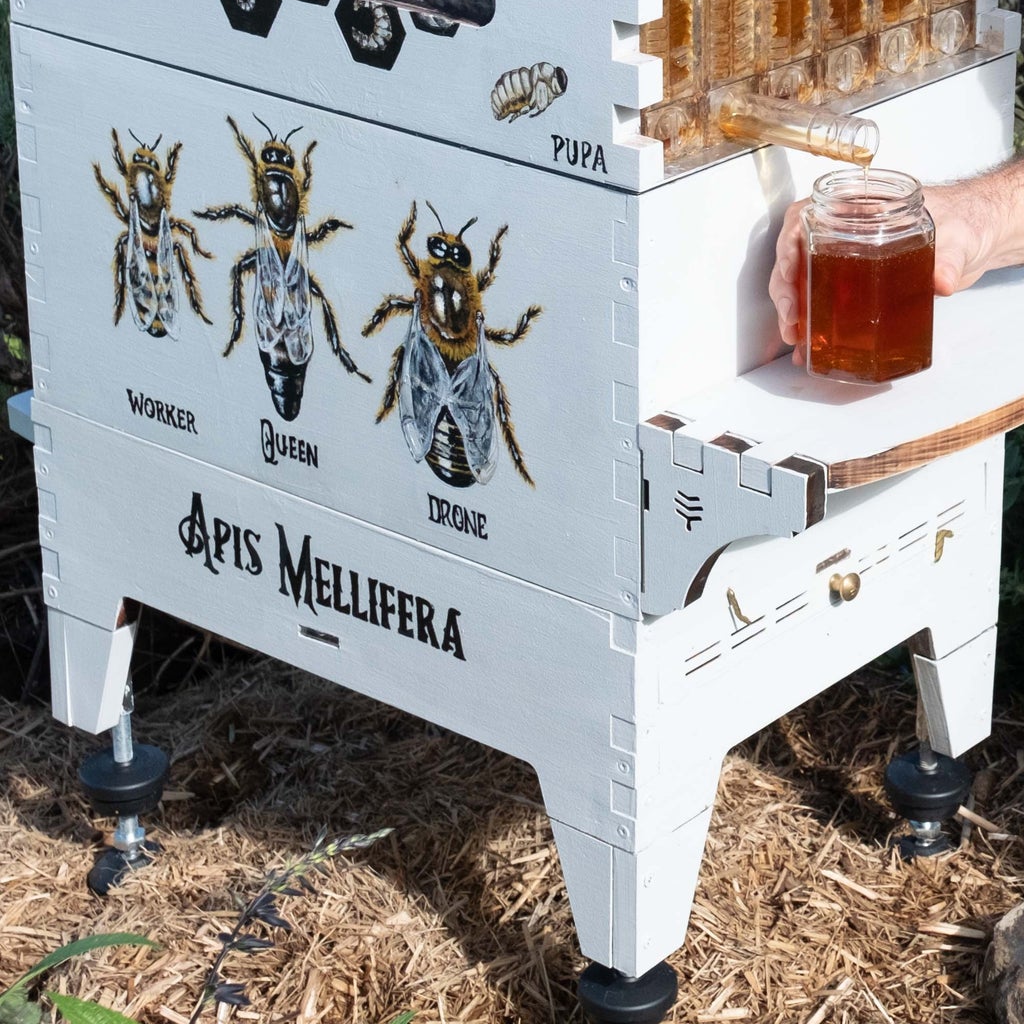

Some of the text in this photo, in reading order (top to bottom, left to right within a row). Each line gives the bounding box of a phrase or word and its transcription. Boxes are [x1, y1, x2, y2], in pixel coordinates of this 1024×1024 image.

[551, 134, 608, 174] PUPA
[126, 388, 198, 435] WORKER
[260, 418, 319, 469] QUEEN
[428, 492, 489, 541] DRONE
[178, 491, 467, 662] APIS MELLIFERA
